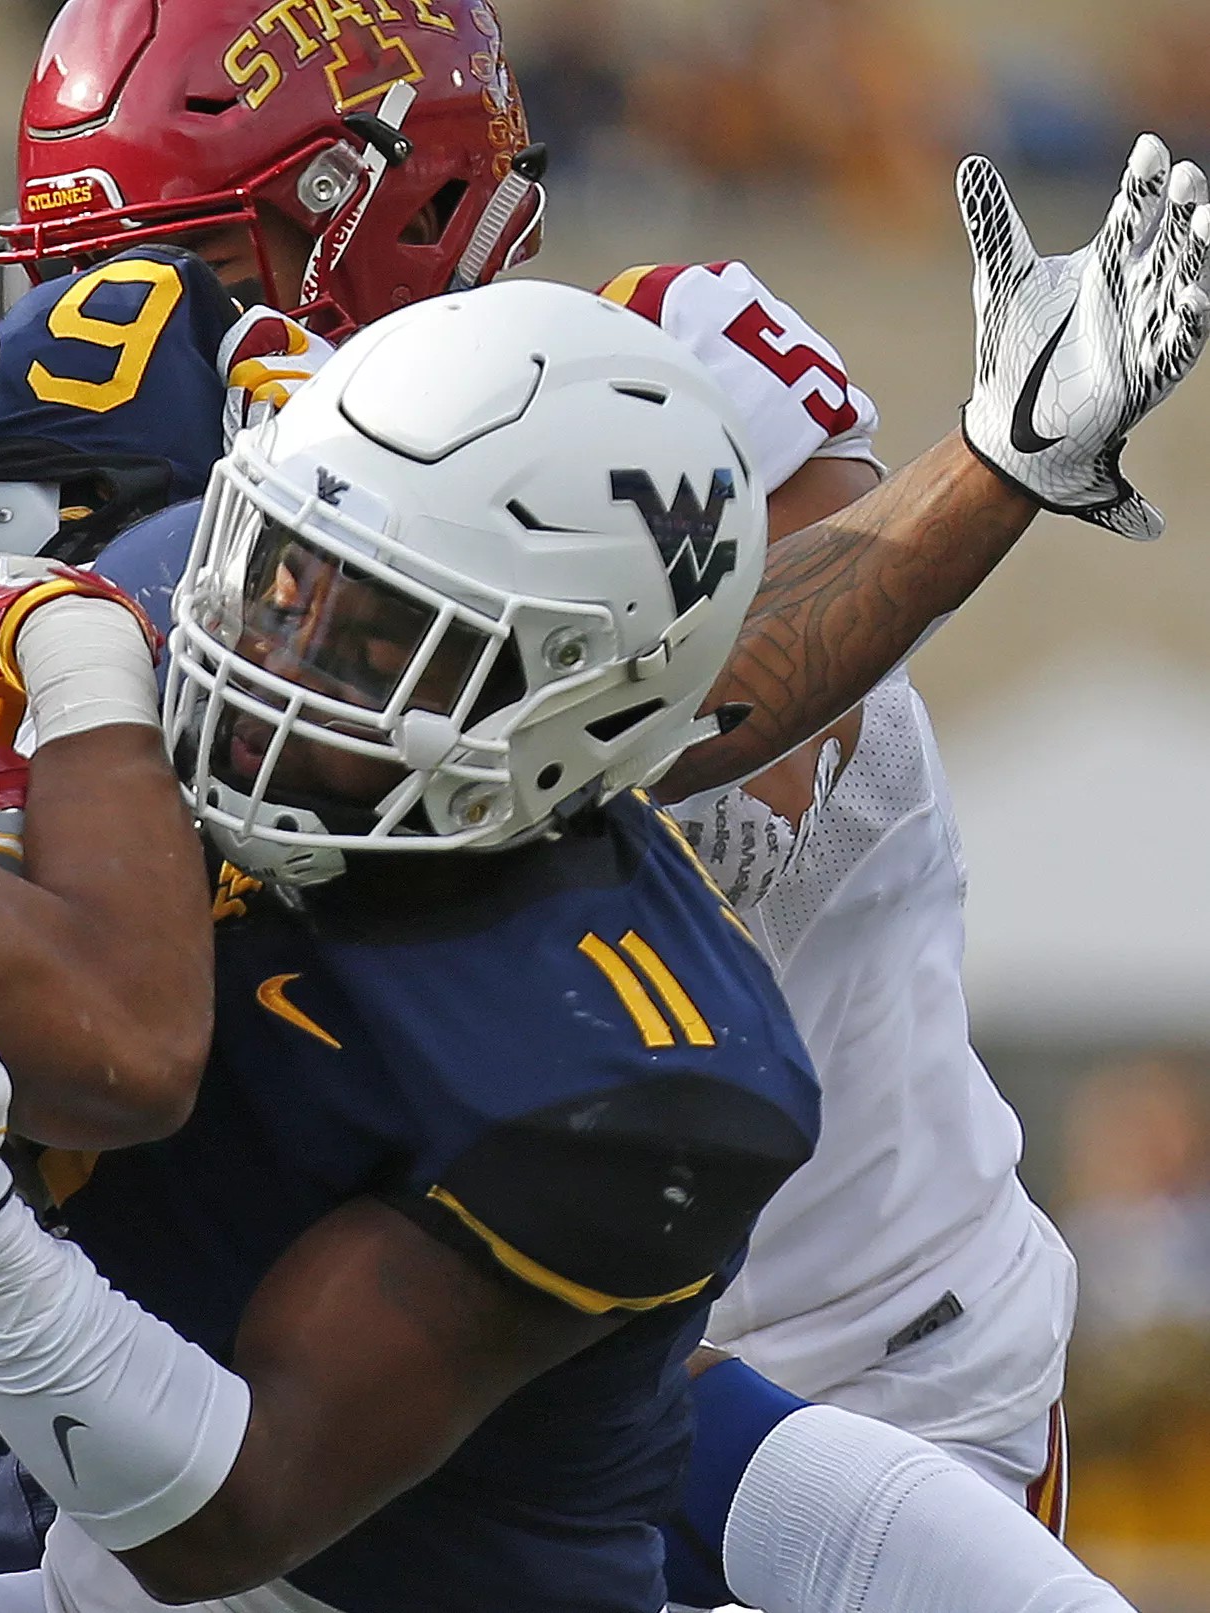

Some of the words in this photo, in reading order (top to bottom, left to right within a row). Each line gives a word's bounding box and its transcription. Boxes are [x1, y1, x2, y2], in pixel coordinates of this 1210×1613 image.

[27, 186, 93, 212] CYCLONES
[26, 259, 184, 413] 9
[722, 298, 859, 438] 5
[578, 929, 716, 1048] 11
